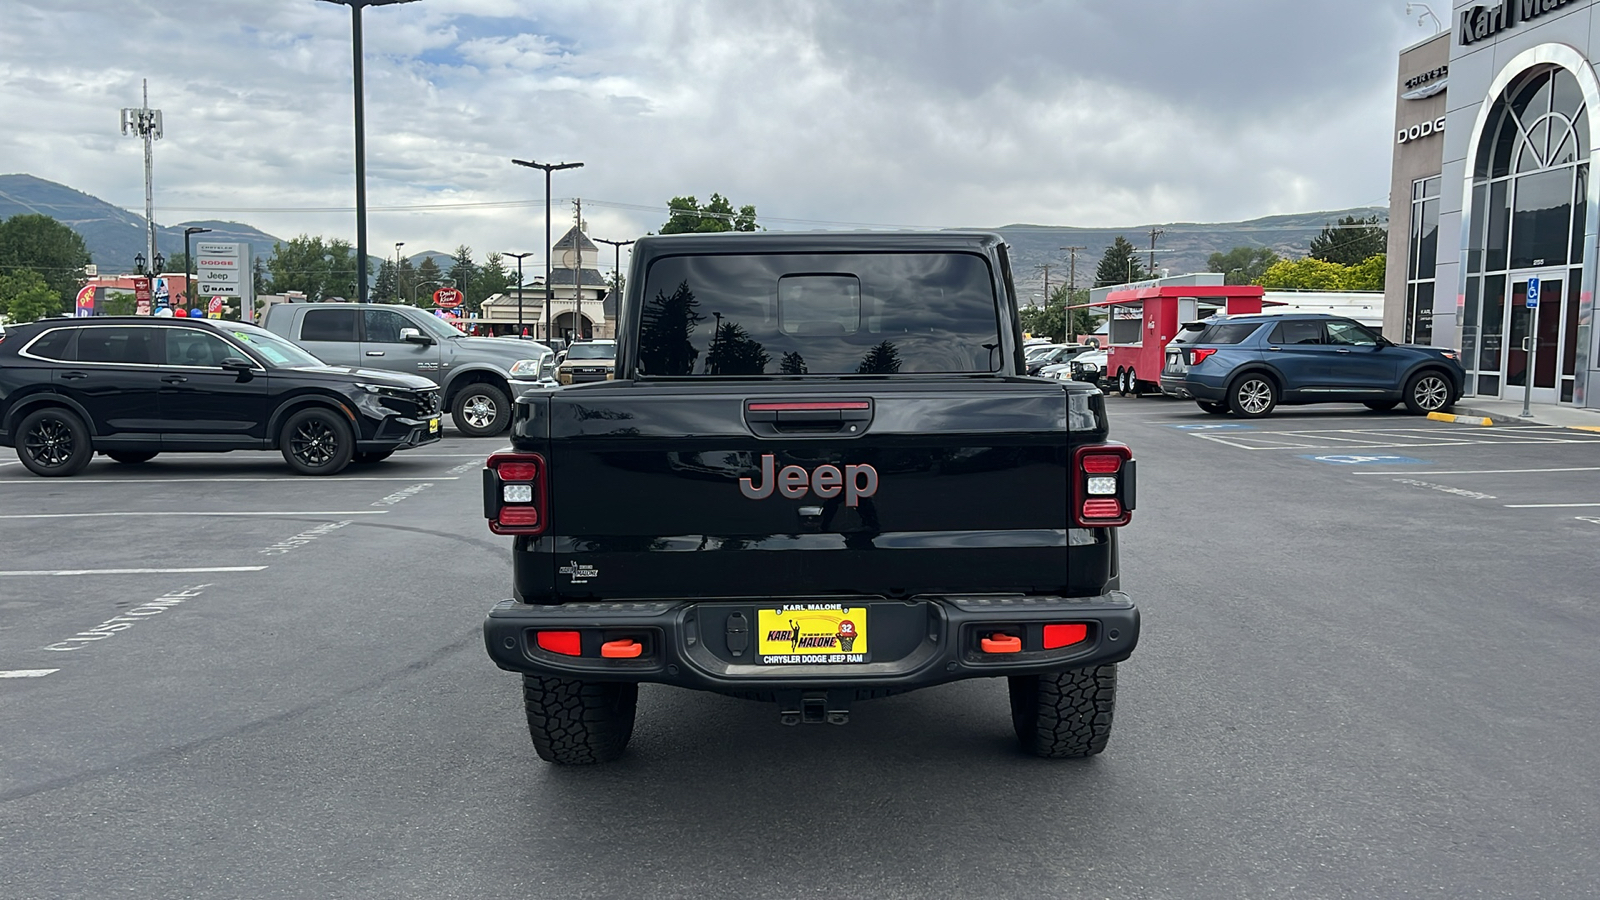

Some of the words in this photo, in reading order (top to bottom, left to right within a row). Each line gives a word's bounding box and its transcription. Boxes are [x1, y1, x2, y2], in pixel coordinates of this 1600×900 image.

[1459, 0, 1512, 45] Karl
[207, 271, 228, 280] Jeep
[80, 287, 94, 306] PRE
[739, 454, 879, 507] Jeep
[841, 623, 852, 633] 32
[766, 630, 793, 641] KARL
[798, 636, 837, 648] MALONE
[764, 655, 801, 664] CHRYSLER
[802, 655, 827, 663] DODGE
[828, 654, 845, 663] JEEP
[847, 654, 863, 663] RAM
